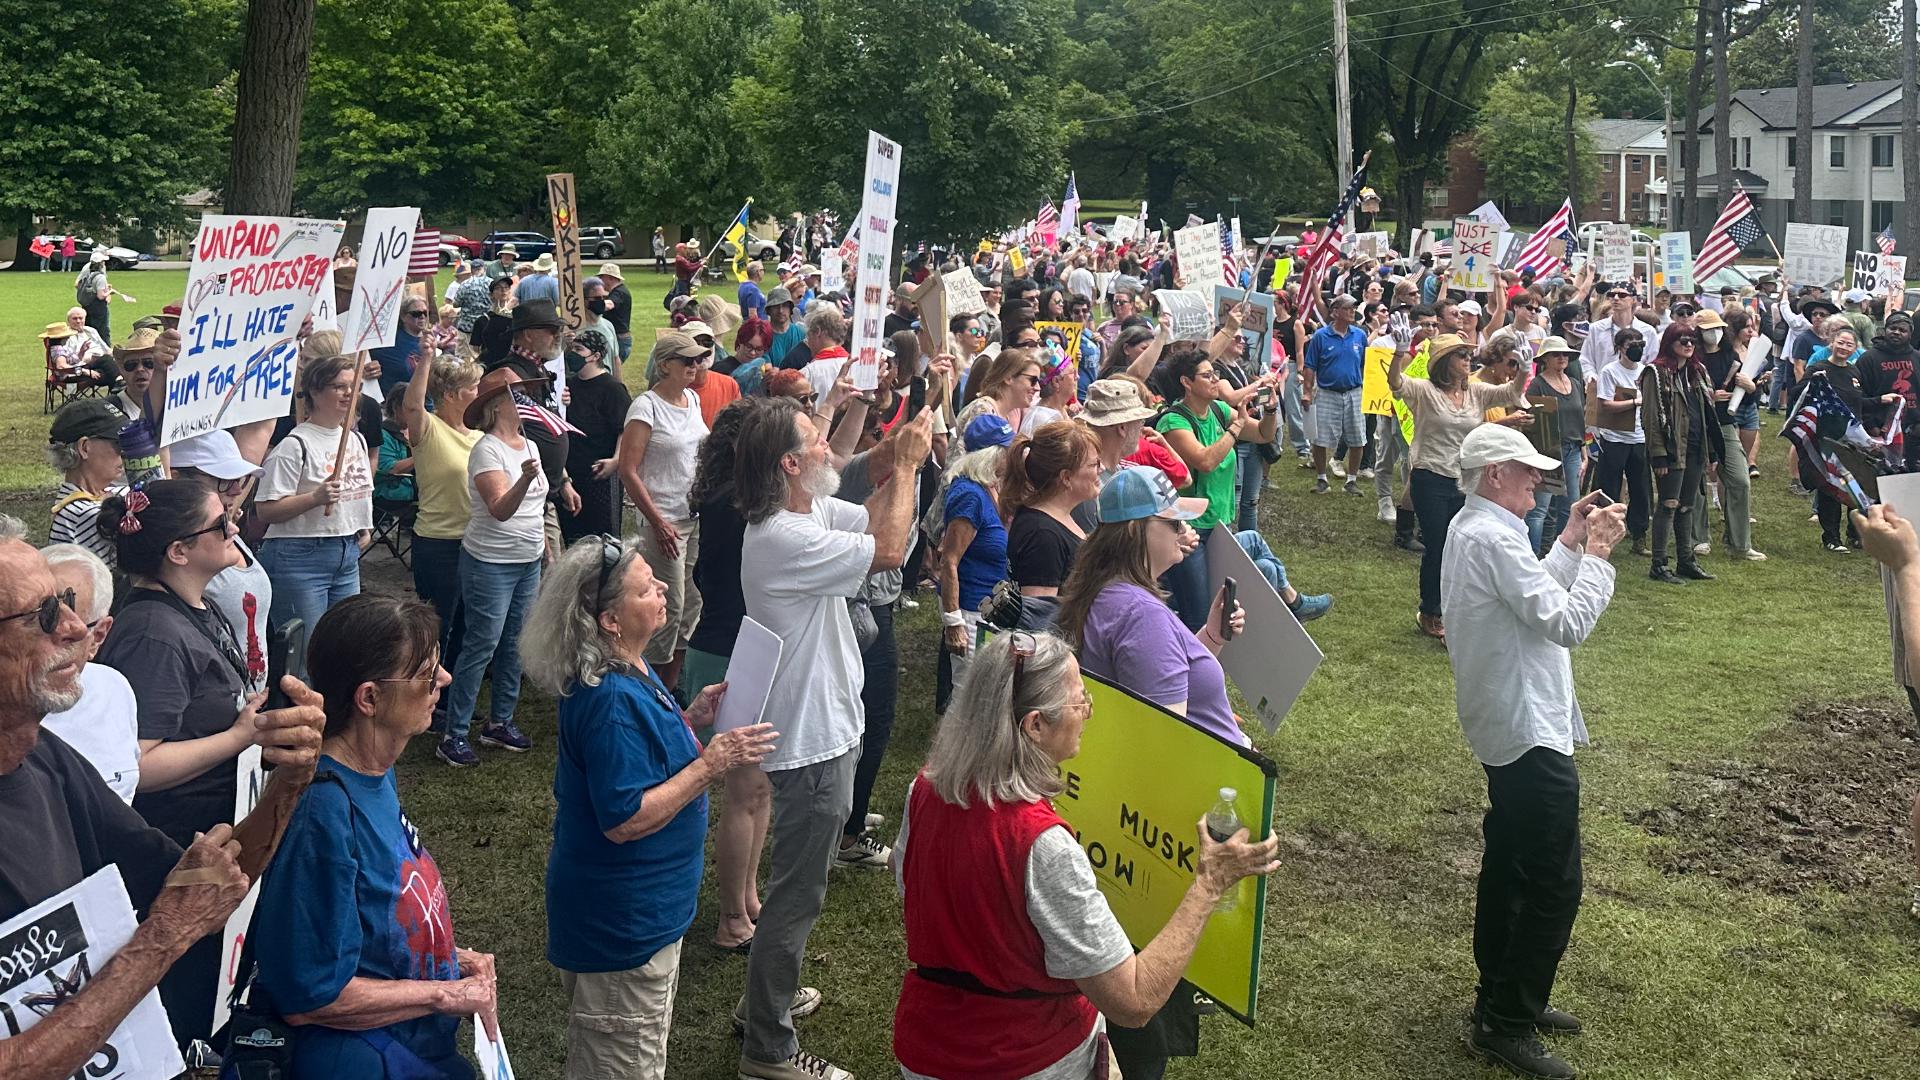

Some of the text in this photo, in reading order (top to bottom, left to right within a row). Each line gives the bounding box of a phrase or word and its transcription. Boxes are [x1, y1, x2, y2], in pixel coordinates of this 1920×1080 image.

[877, 139, 894, 160] SUPER
[869, 216, 889, 234] FRAGILE
[199, 219, 280, 263] UNPAID
[371, 225, 408, 270] NO
[867, 253, 885, 271] RACIST
[1465, 256, 1475, 271] 4
[1855, 253, 1878, 272] NO
[229, 254, 330, 297] PROTESTER
[558, 227, 583, 330] KINGS
[1452, 272, 1488, 288] ALL
[1854, 272, 1876, 291] NO
[319, 300, 328, 320] A
[1171, 295, 1192, 308] NO
[188, 304, 294, 356] I'LL HATE
[863, 318, 878, 338] NAZI
[1881, 360, 1913, 371] SOUTH
[167, 345, 297, 410] HIM FOR FREE
[1119, 802, 1195, 873] MUSK
